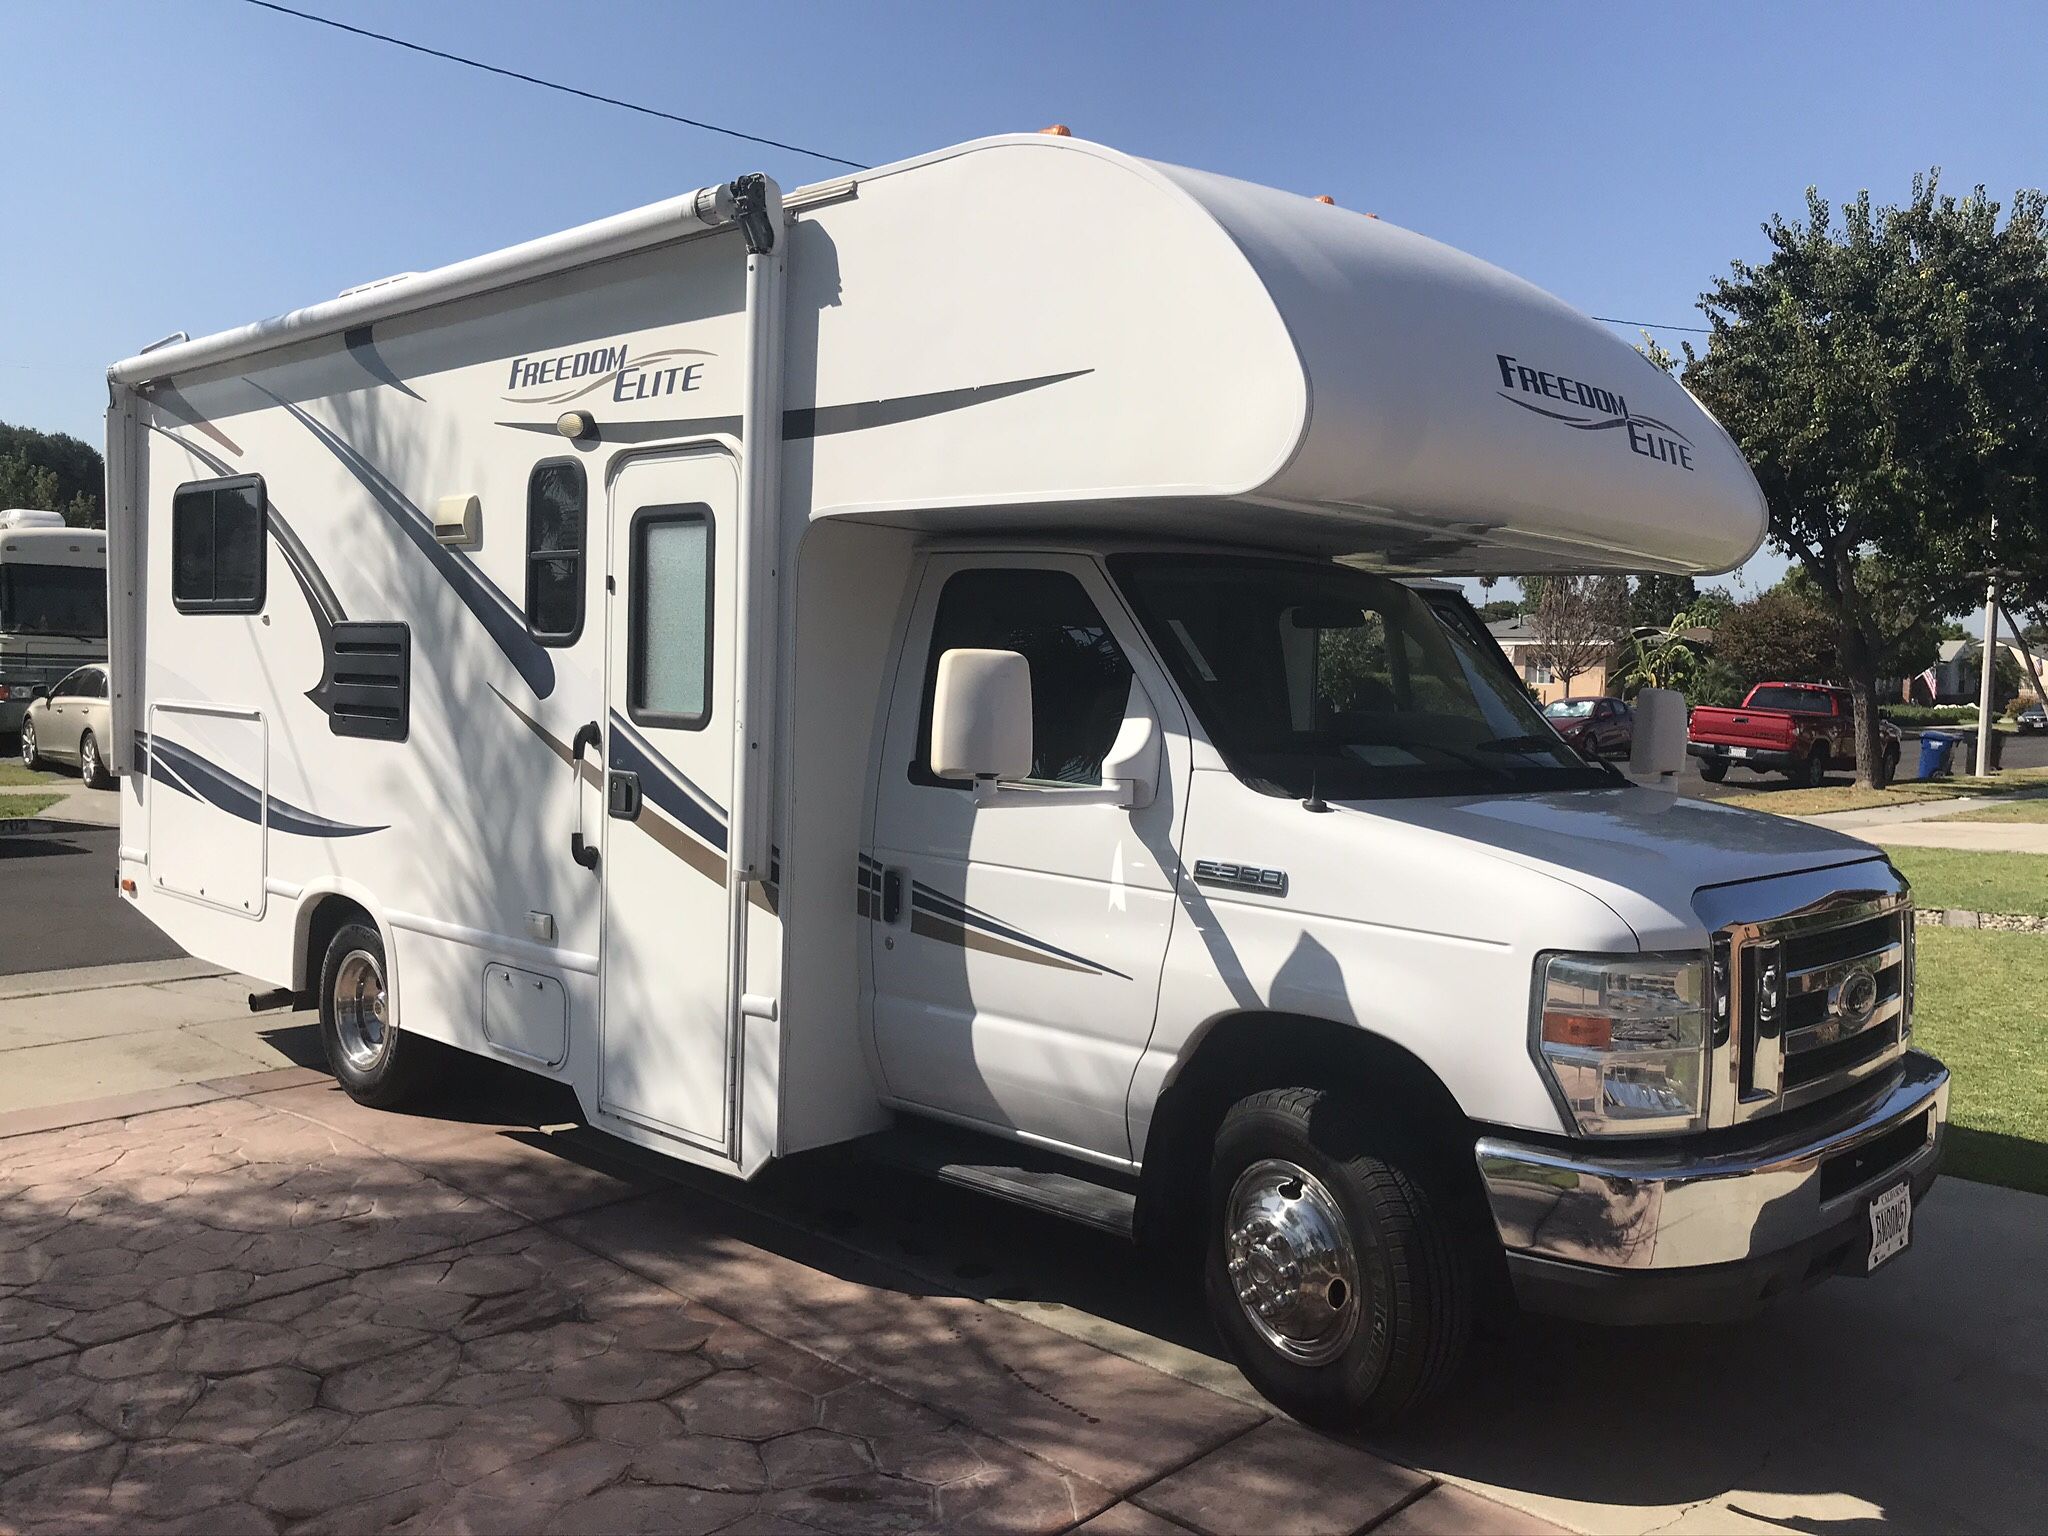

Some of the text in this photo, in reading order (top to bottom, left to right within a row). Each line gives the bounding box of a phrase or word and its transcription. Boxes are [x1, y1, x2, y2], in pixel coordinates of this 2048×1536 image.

[508, 344, 628, 390] FREEDOM
[613, 363, 704, 403] ELITE
[1496, 354, 1629, 420] FREEDOM
[1626, 420, 1694, 471] ELITE
